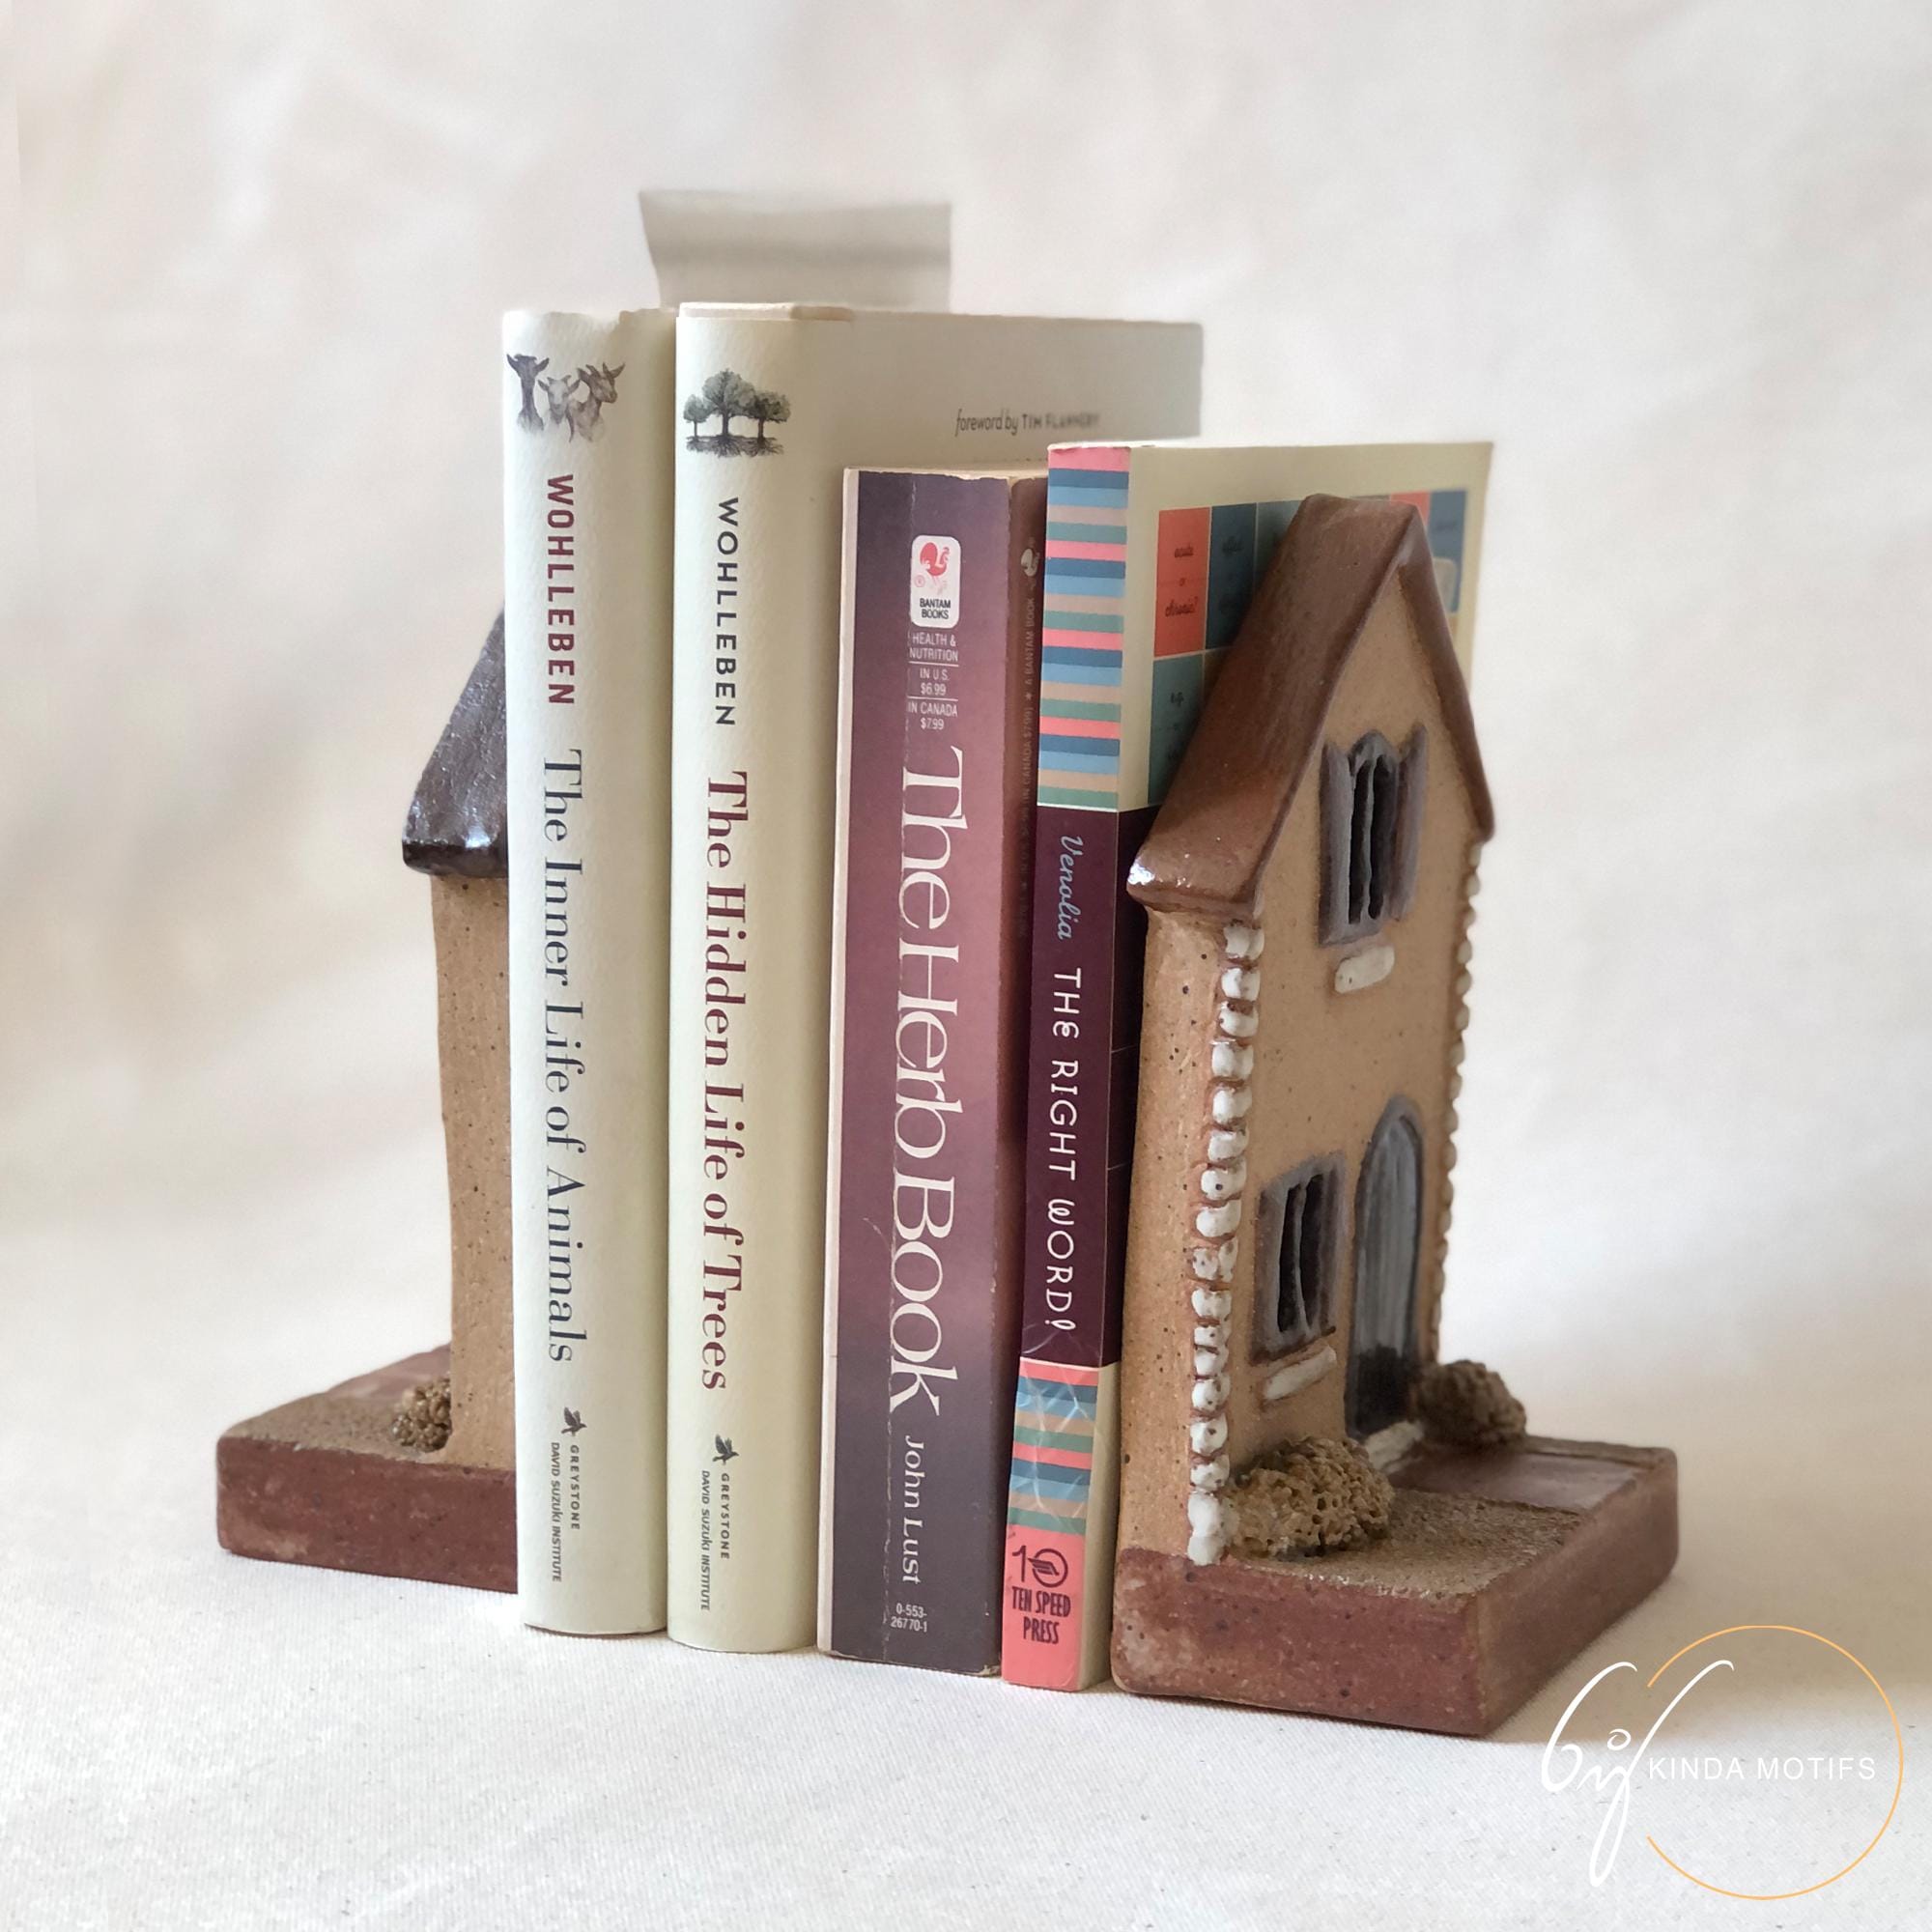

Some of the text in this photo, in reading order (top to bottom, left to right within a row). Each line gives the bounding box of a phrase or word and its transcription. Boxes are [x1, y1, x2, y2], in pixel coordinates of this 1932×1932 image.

[954, 409, 1003, 437] foreword
[1005, 409, 1018, 436] by
[547, 474, 575, 705] WOHLLEBEN
[715, 497, 739, 726] WOHLLEBEN
[920, 598, 951, 609] BANTAM
[922, 609, 949, 620] BOOKS
[1026, 598, 1036, 627] BOOK
[909, 648, 958, 662] NUTRITION
[912, 632, 956, 647] HEALTH &
[920, 668, 929, 679] IN
[908, 701, 958, 717] IN CANADA
[921, 682, 947, 696] $6.99
[898, 745, 969, 929] The
[1057, 836, 1084, 940] Venolia
[544, 748, 588, 1362] The Inner Life of Animals
[701, 771, 749, 1389] The Hidden Life of Trees
[894, 937, 964, 1159] Herb
[1045, 967, 1082, 1330] THE RIGHT WORD!
[551, 1442, 563, 1582] DAVID SUZUKI INSTITUTE
[570, 1444, 581, 1530] GREYSTONE
[720, 1472, 730, 1559] GREYSTONE
[902, 1435, 925, 1584] John Lust
[700, 1470, 713, 1611] DAVID SUZUKI INSTITUTE
[890, 1616, 928, 1633] 26770-1
[1011, 1586, 1071, 1618] TEN SPEED
[1023, 1616, 1060, 1645] PRESS
